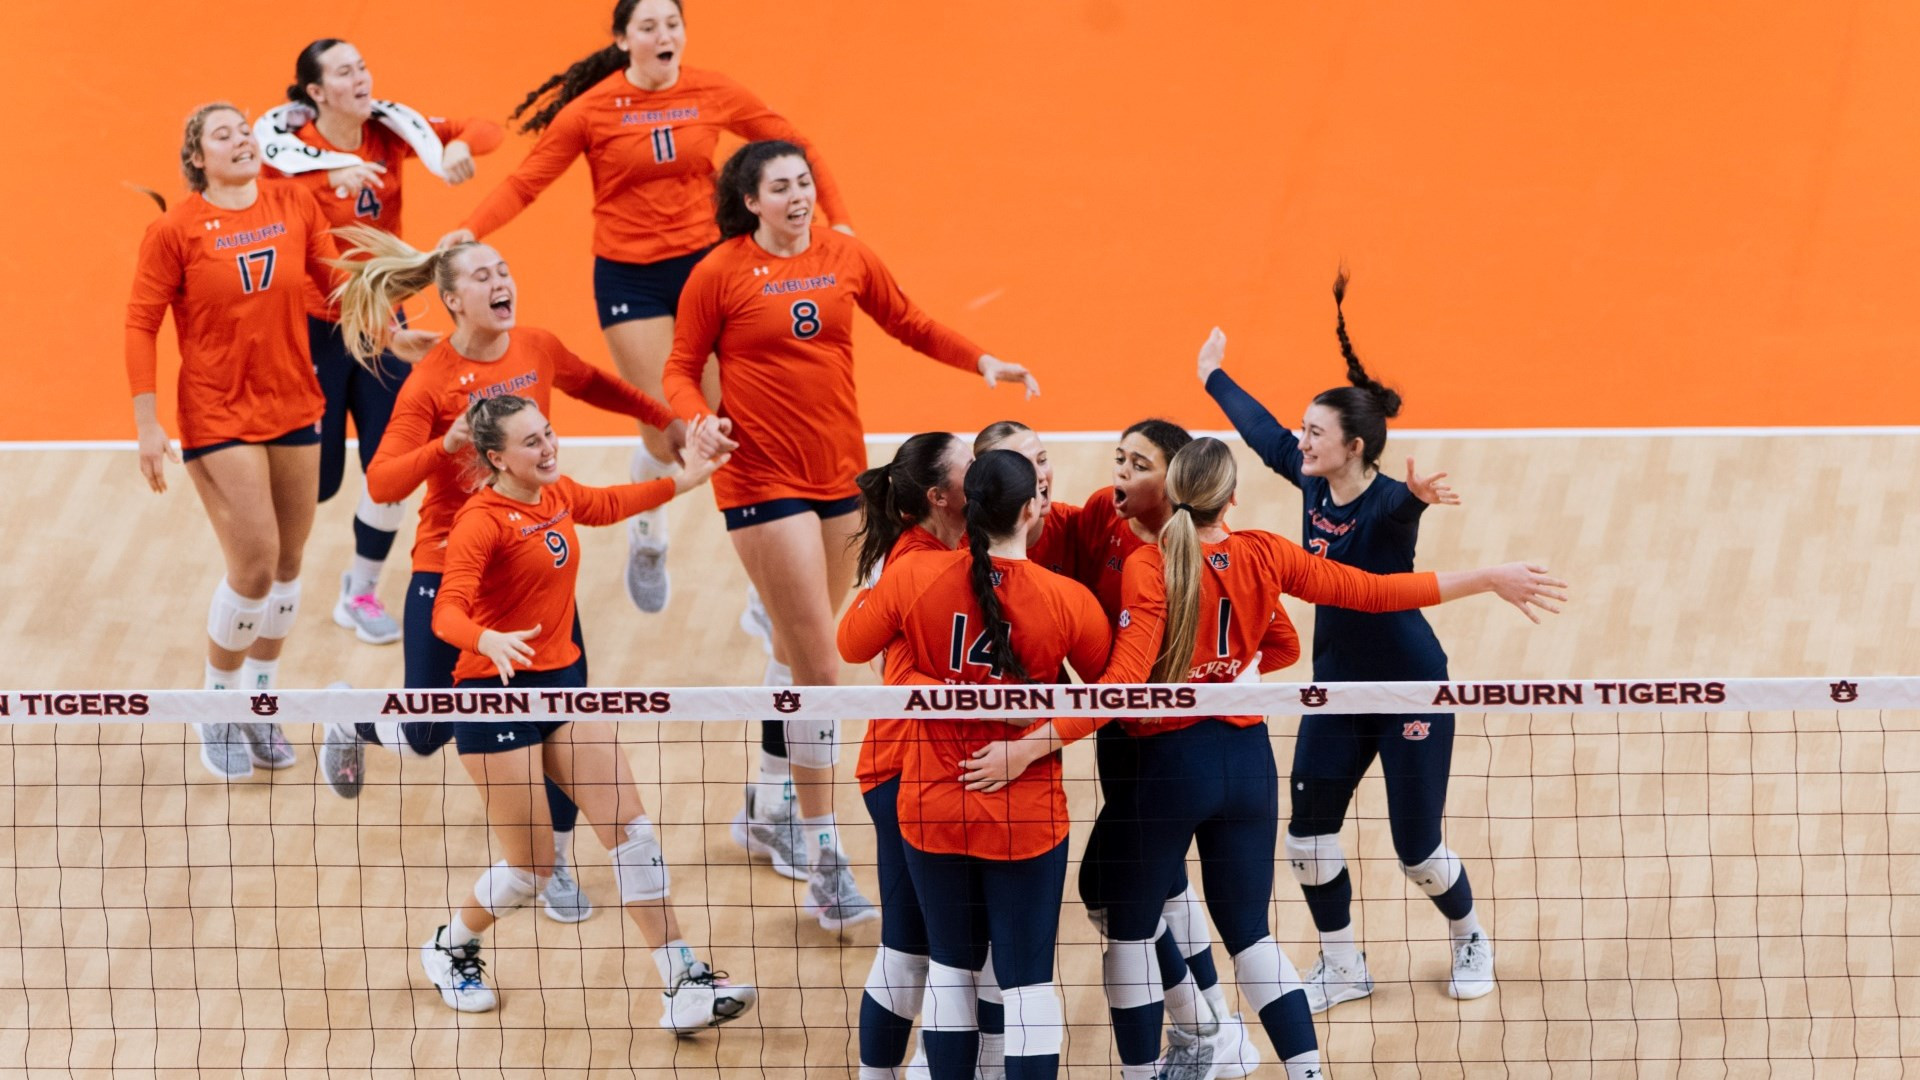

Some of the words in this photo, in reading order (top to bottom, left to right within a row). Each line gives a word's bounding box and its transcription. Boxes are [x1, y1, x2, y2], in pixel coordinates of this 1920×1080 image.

[622, 106, 699, 127] AUBURN
[650, 125, 677, 164] 11
[354, 185, 383, 220] 4
[215, 222, 287, 250] AUBURN
[236, 246, 277, 294] 17
[762, 272, 836, 296] AUBURN
[790, 299, 822, 340] 8
[544, 529, 569, 568] 9
[1216, 597, 1232, 659] 1
[949, 611, 1012, 680] 14
[20, 693, 149, 716] TIGERS
[381, 692, 530, 714] AUBURN
[541, 691, 671, 714] TIGERS
[904, 688, 1055, 711] AUBURN
[1065, 687, 1197, 709] TIGERS
[1432, 684, 1583, 706] AUBURN
[1594, 682, 1726, 704] TIGERS
